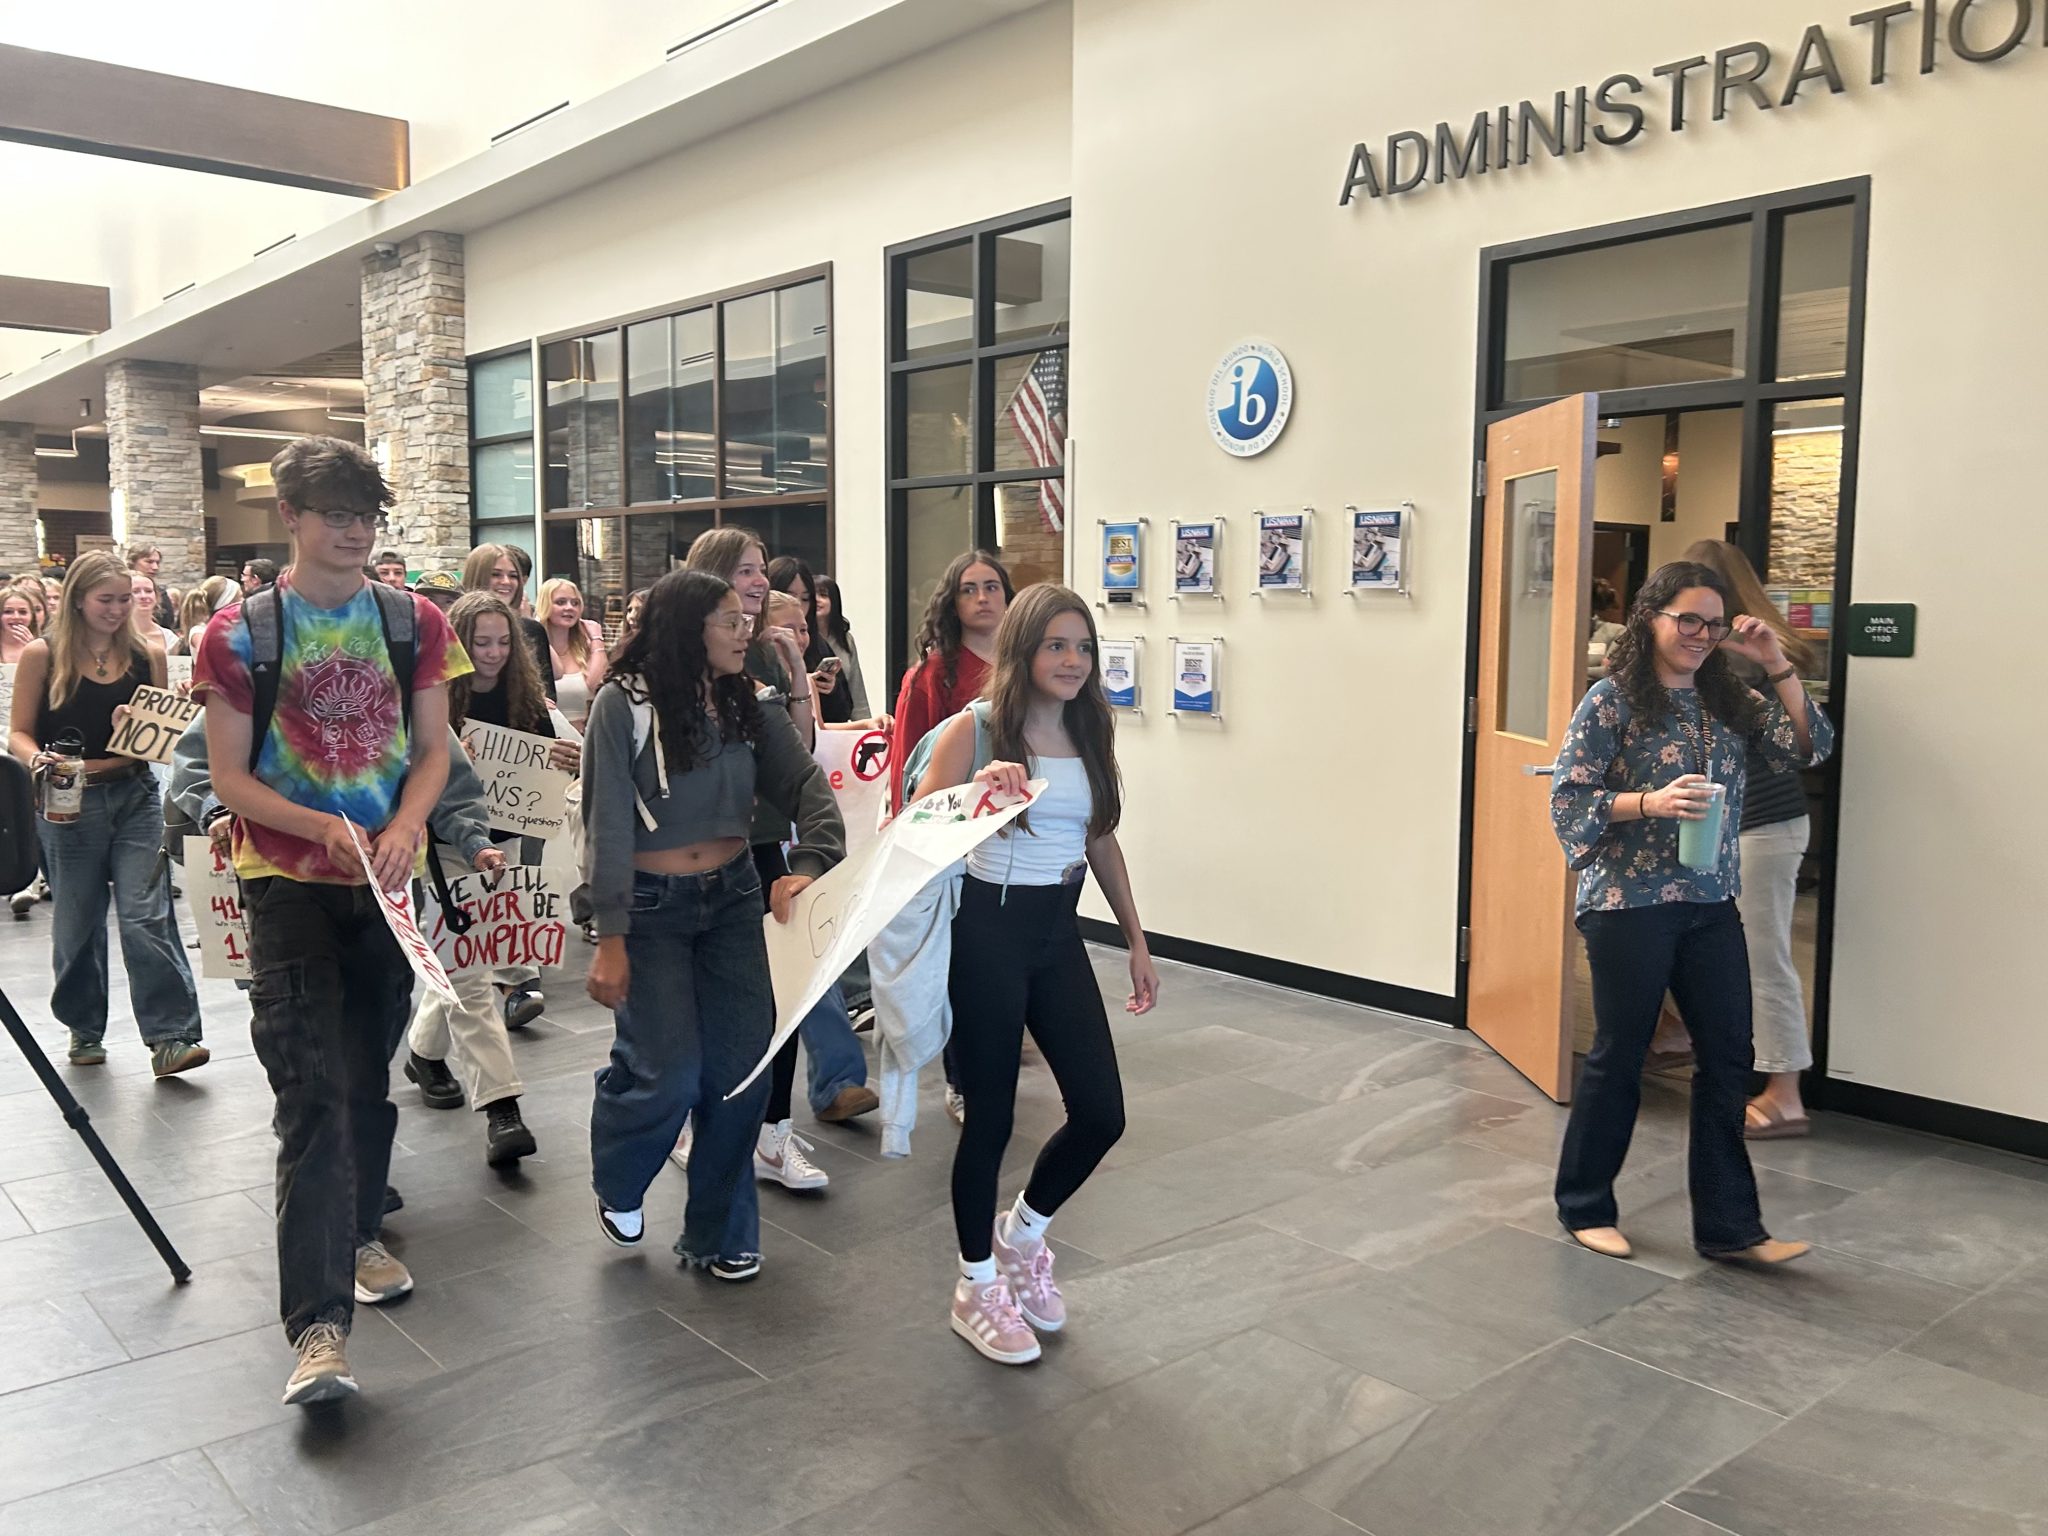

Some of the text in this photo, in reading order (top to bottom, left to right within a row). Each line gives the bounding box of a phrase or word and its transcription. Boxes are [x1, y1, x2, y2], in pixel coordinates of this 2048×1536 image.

[1339, 0, 2048, 206] ADMINISTRATIO
[111, 717, 184, 760] NOT
[496, 770, 518, 778] or
[947, 793, 962, 812] You
[517, 815, 563, 830] question?
[480, 866, 548, 894] WILL
[533, 892, 560, 919] BE
